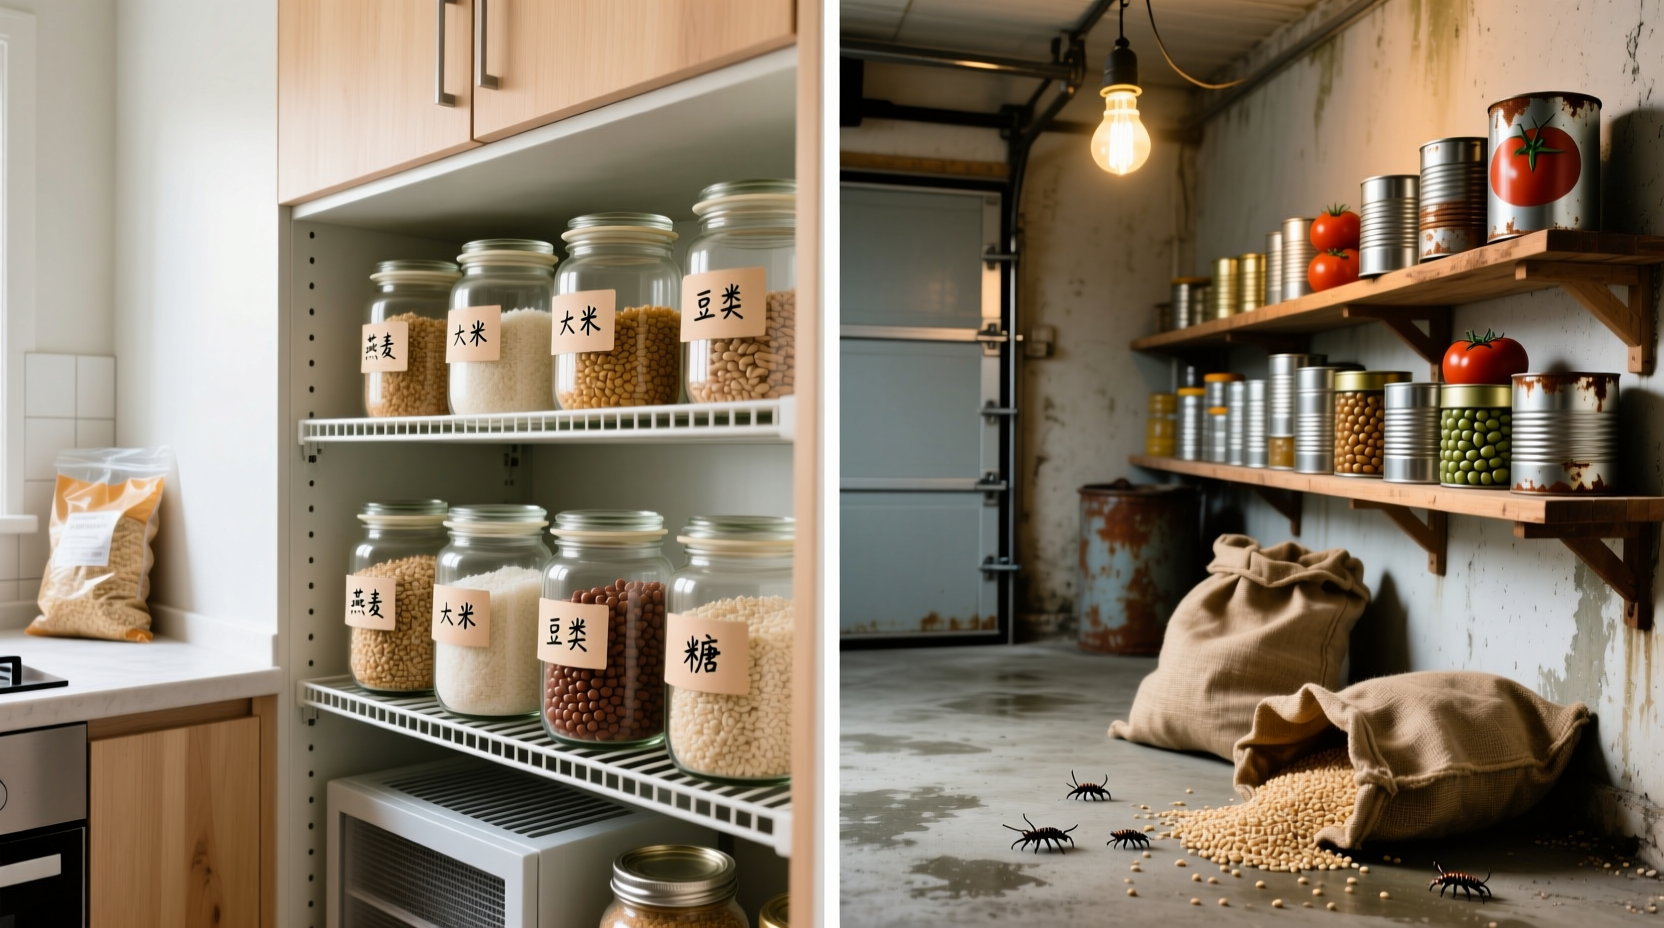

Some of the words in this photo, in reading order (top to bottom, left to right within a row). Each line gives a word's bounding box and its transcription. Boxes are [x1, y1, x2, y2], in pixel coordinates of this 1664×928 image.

[693, 282, 744, 322] 豆类
[454, 319, 489, 348] 大米
[559, 304, 603, 337] 大米
[439, 601, 478, 631] 大米
[545, 617, 589, 654] 豆类
[682, 633, 723, 674] 糖
